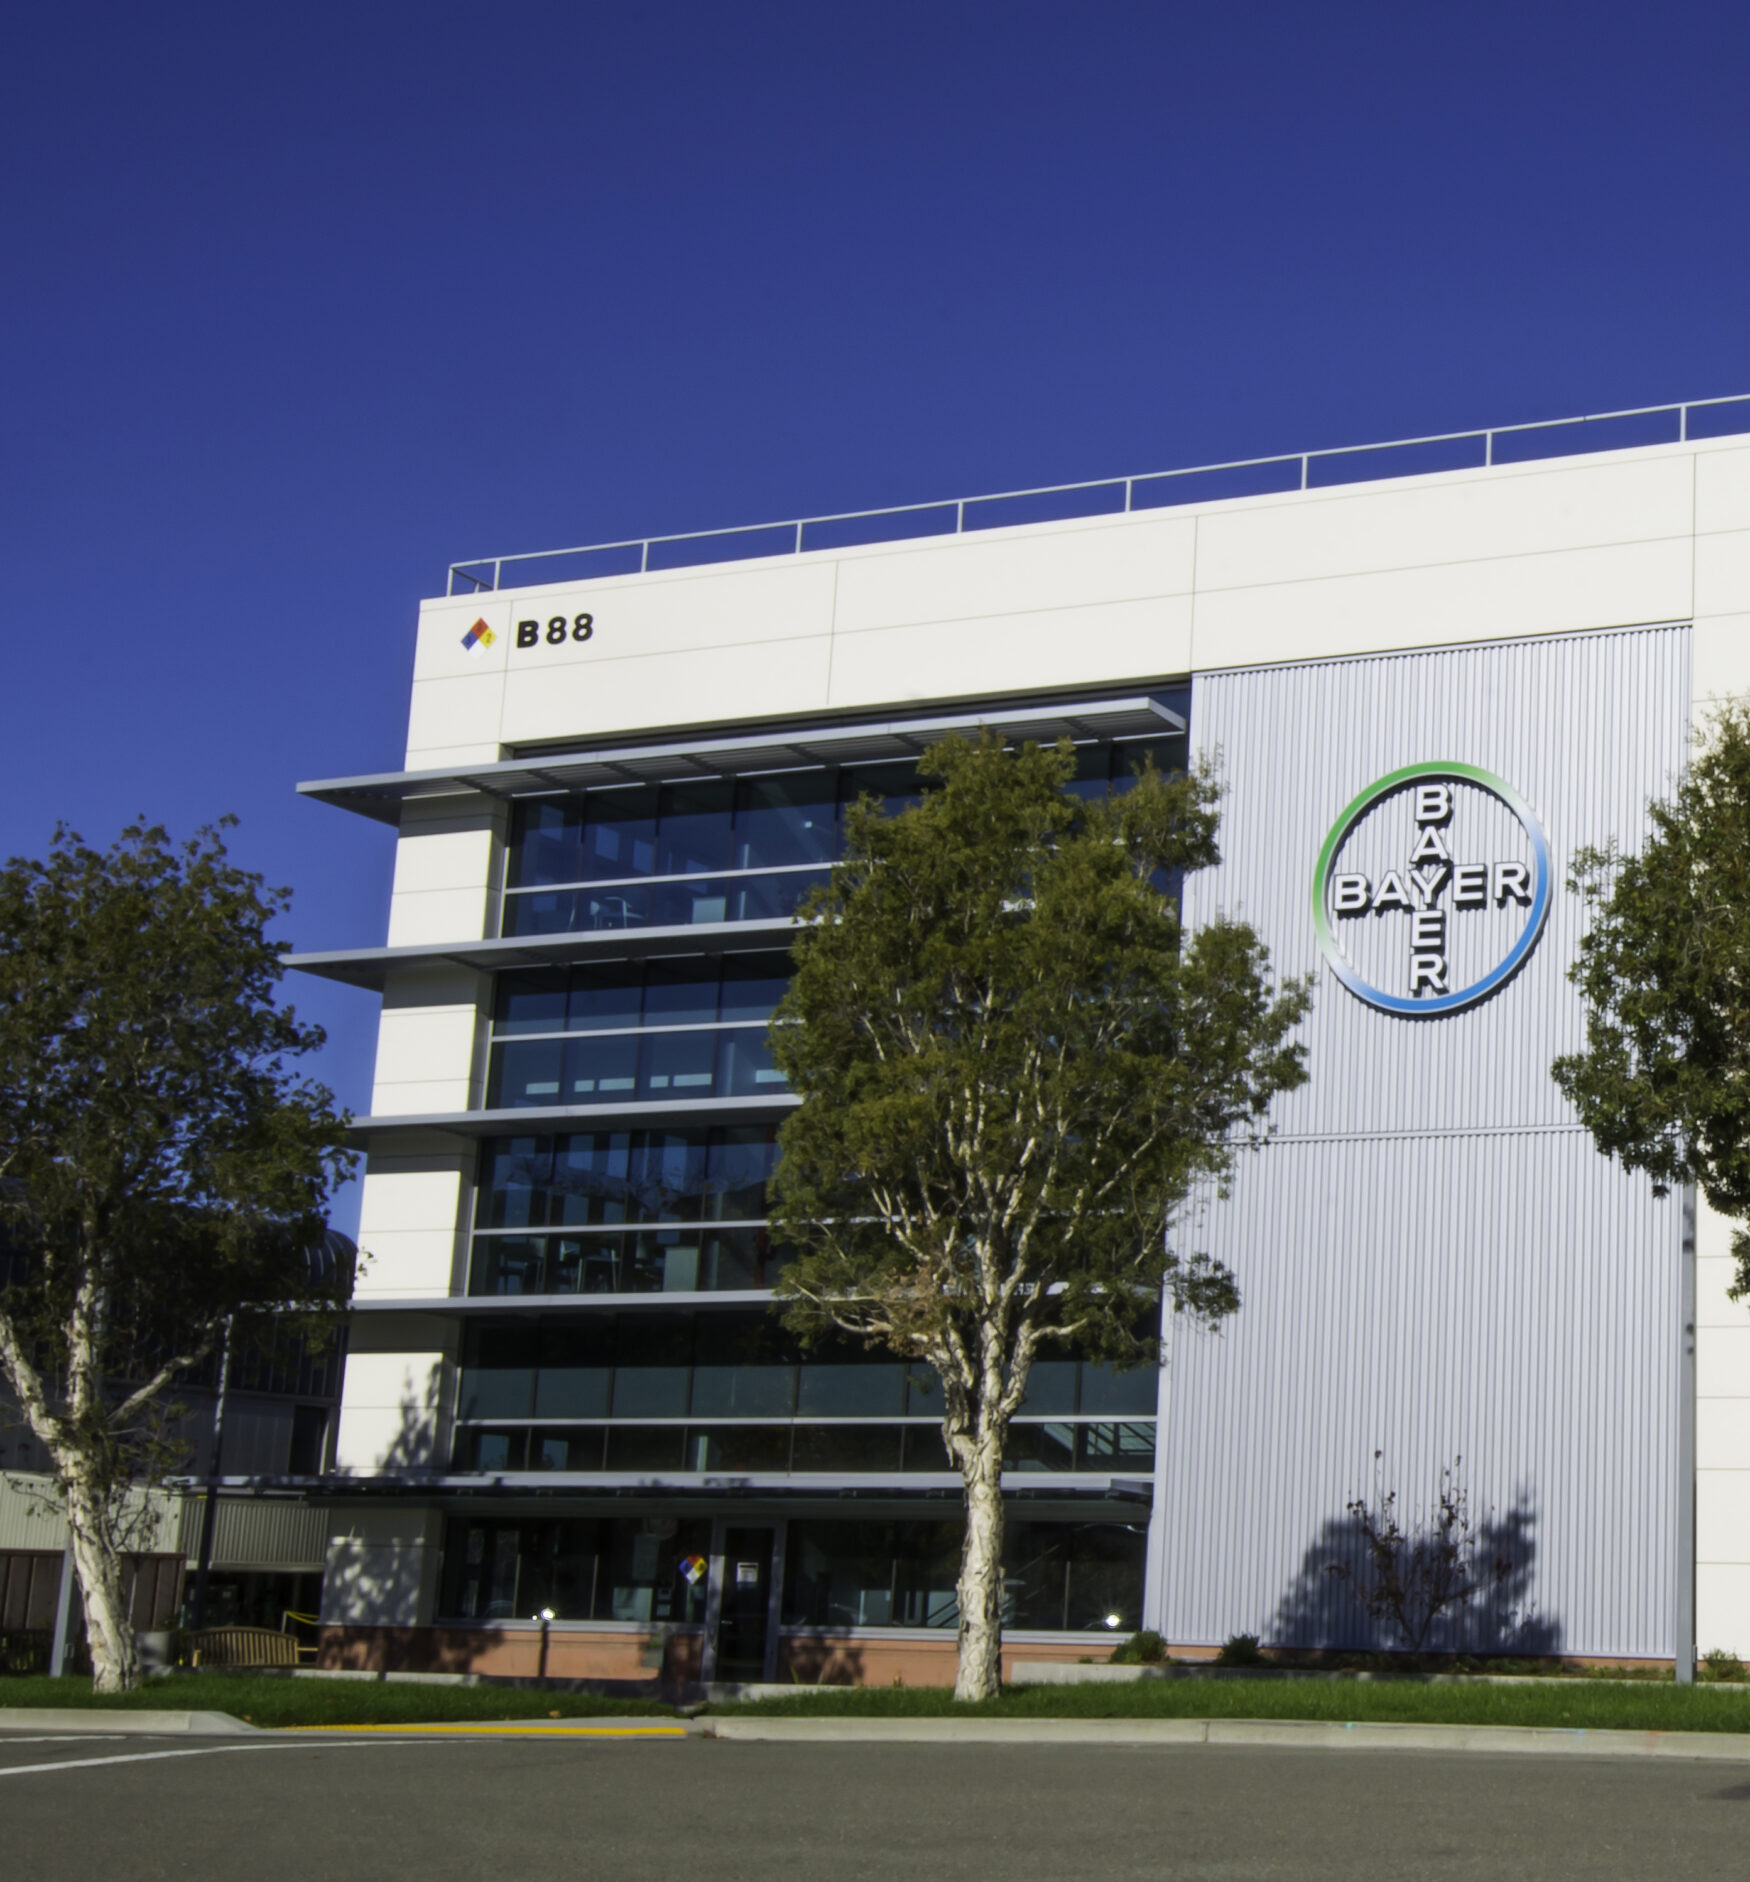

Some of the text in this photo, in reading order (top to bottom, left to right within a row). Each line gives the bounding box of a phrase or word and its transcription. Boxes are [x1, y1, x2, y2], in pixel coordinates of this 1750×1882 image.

[516, 613, 593, 648] B88
[1333, 861, 1528, 911] BAYER
[1409, 784, 1450, 992] BAYER
